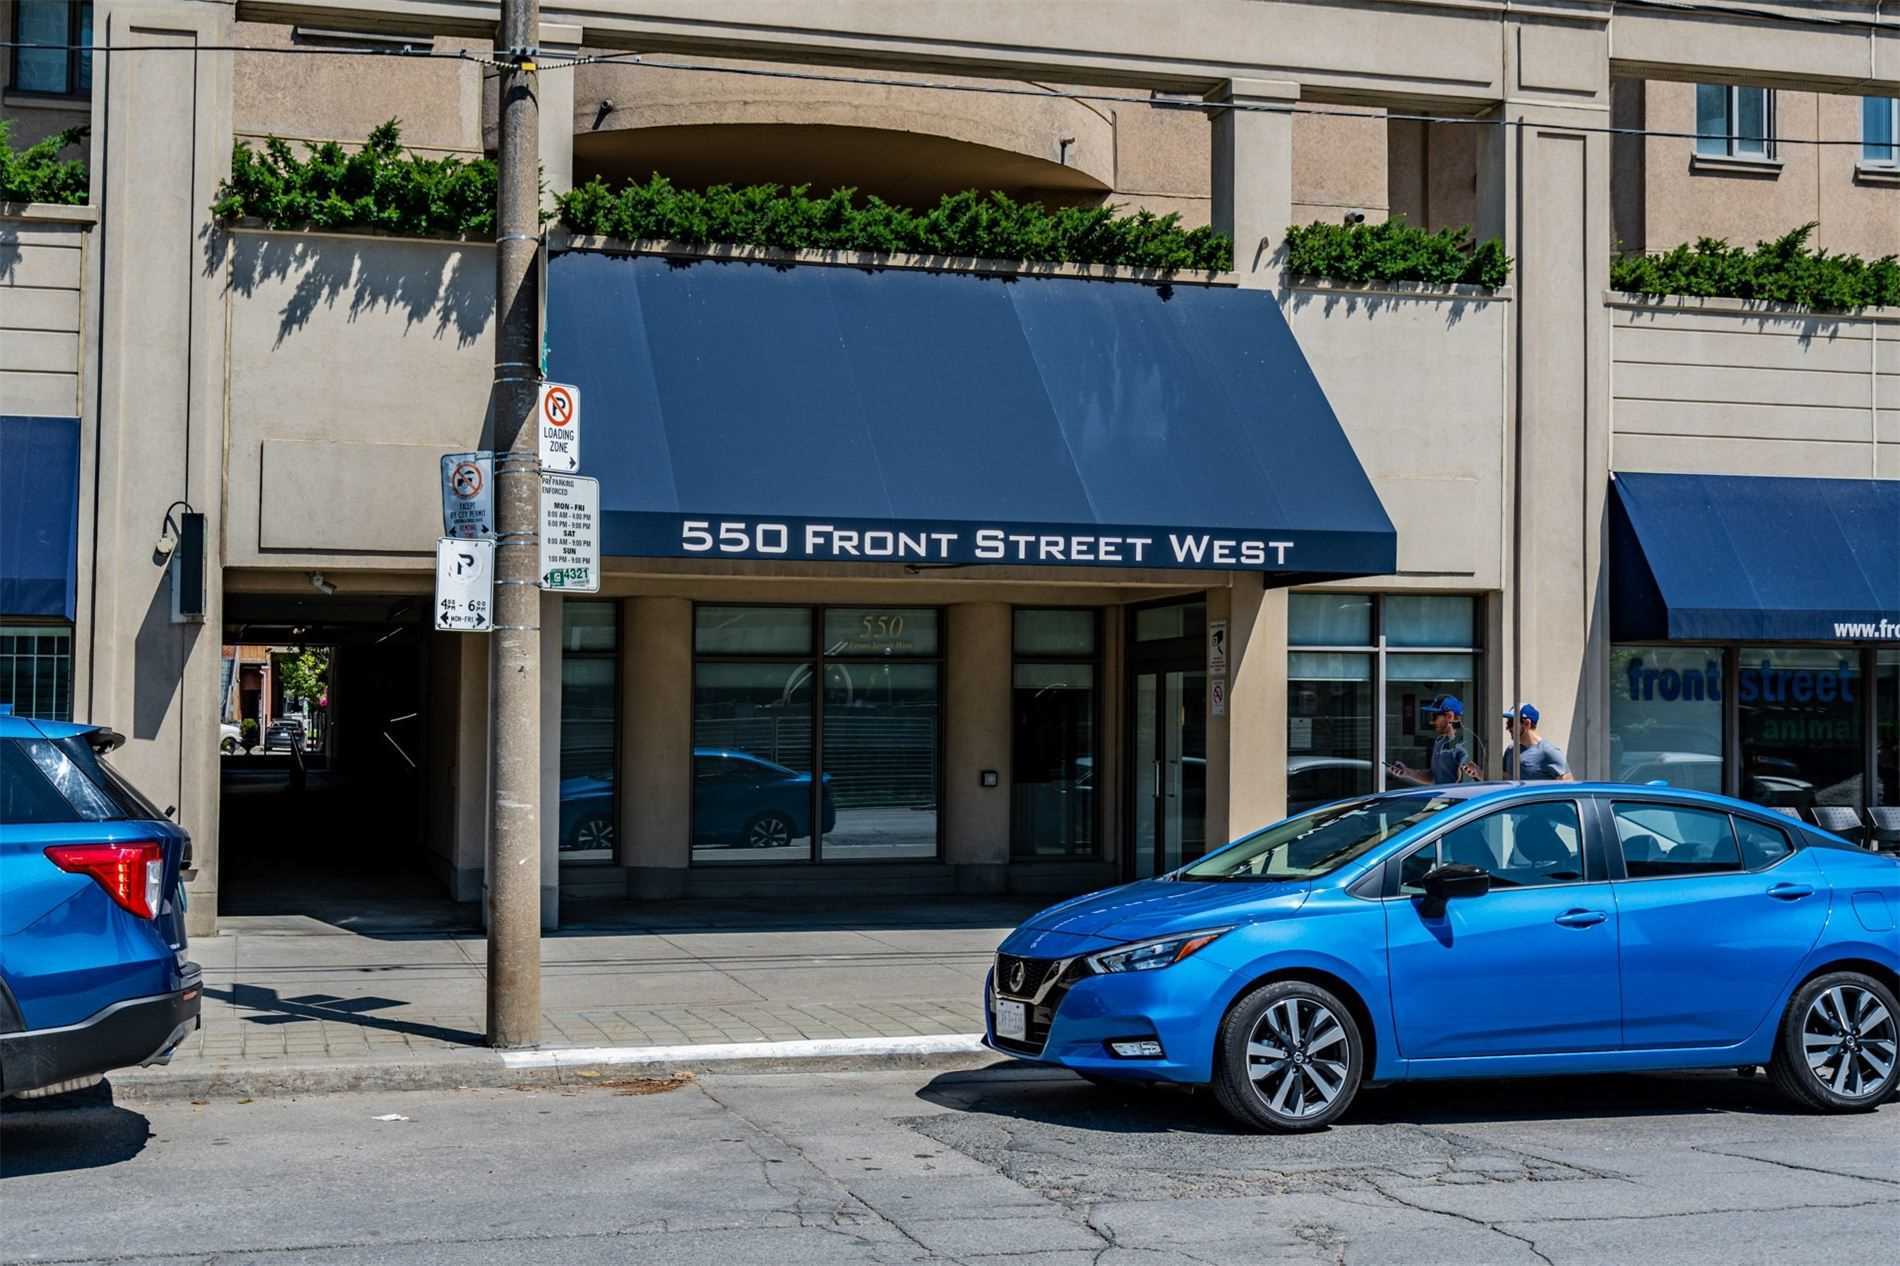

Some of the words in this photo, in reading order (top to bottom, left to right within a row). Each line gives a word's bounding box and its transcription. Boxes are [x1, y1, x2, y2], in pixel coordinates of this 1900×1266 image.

[543, 427, 575, 441] LOADING
[550, 441, 568, 454] ZONE
[553, 478, 575, 488] PARKING
[542, 487, 569, 496] ENFORCED
[554, 502, 570, 510] MON
[574, 503, 585, 511] FRI
[559, 511, 568, 519] AM
[583, 513, 592, 521] PM
[559, 520, 568, 528] PM
[583, 522, 591, 530] PM
[682, 521, 788, 553] 550
[563, 547, 577, 555] SUN
[563, 567, 590, 580] 4321
[859, 615, 904, 638] 550
[1626, 657, 1721, 701] front
[1739, 659, 1857, 704] street
